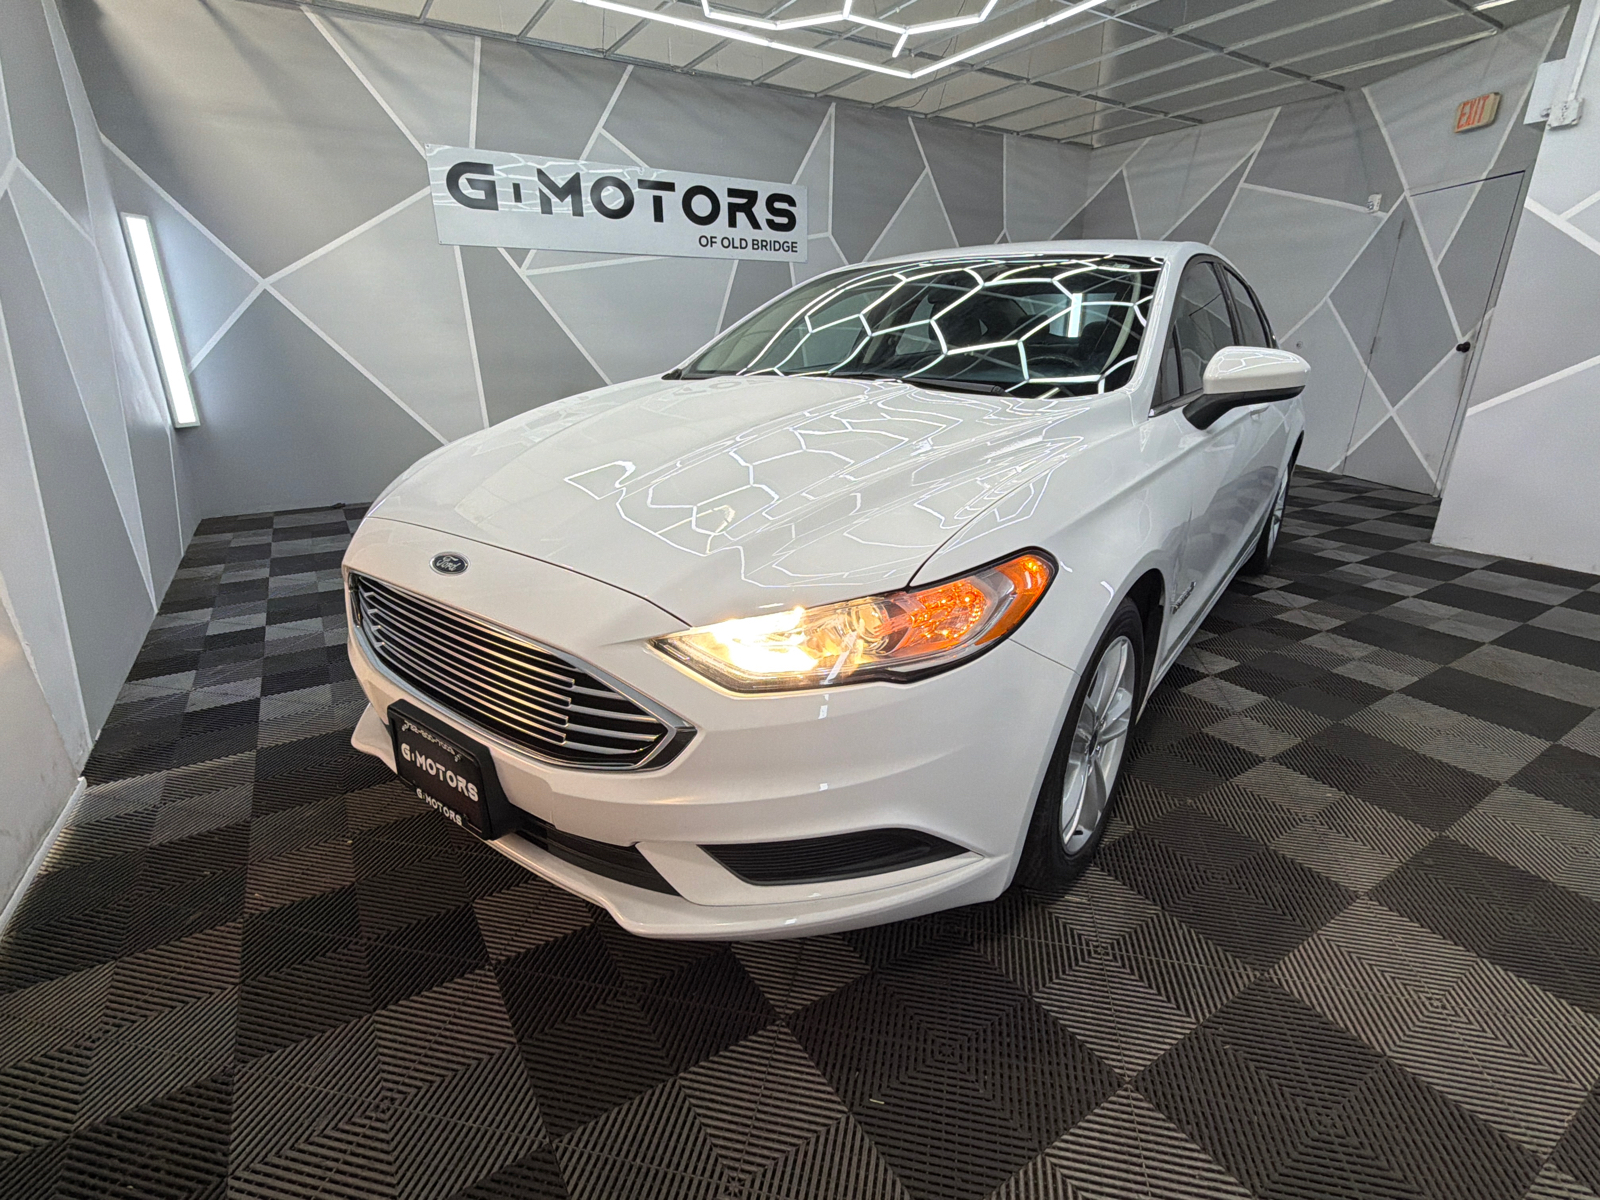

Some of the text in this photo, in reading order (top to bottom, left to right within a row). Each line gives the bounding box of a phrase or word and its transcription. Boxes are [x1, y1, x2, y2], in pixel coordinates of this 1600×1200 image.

[1457, 94, 1490, 129] EXIT
[698, 235, 798, 253] OF OLD BRIDGE
